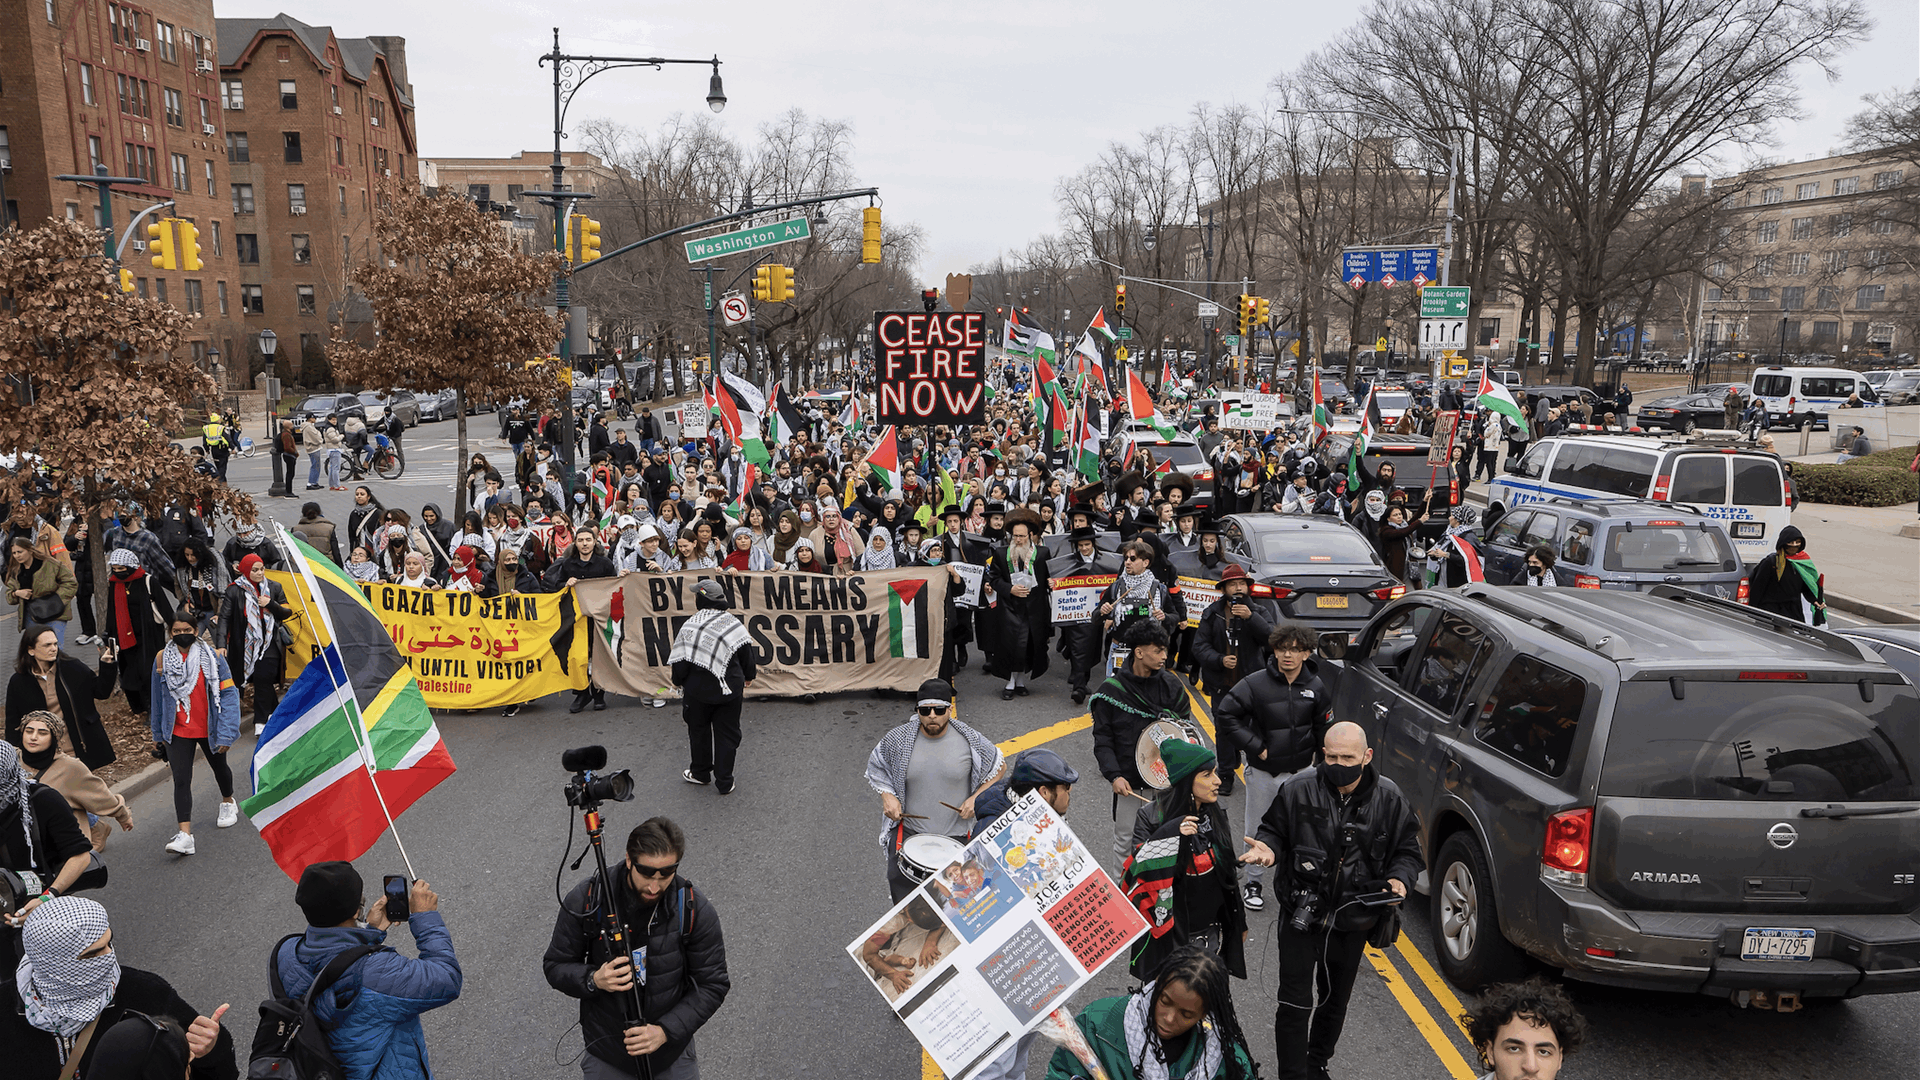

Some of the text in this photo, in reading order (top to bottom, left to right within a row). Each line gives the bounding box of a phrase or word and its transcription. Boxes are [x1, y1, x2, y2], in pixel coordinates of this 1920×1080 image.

[694, 225, 800, 256] Washington Av
[1380, 252, 1399, 260] Brooklyn
[1412, 251, 1431, 259] Brooklyn
[1346, 259, 1370, 267] Children's
[879, 314, 983, 348] CEASE
[886, 348, 977, 379] FIRE
[685, 404, 705, 412] JEWS
[881, 380, 983, 417] NOW
[1510, 492, 1545, 508] NYP
[649, 575, 867, 612] BY NY MEANS
[1055, 577, 1084, 588] Judaism
[382, 587, 435, 616] GAZA
[446, 593, 472, 617] TO
[1057, 612, 1072, 620] And
[1058, 603, 1087, 611] "Israel"
[408, 626, 466, 653] حتى
[468, 623, 519, 658] ثورة
[642, 614, 880, 667] NSSARY
[421, 658, 468, 678] UNTIL
[978, 793, 1037, 846] GENOCIDE
[1030, 812, 1054, 835] JOE
[1032, 855, 1087, 906] JOE GO!
[1630, 872, 1914, 884] ARMADA SE
[1047, 877, 1101, 924] THOSE SILENT
[1053, 882, 1110, 932] IN THE FACE OF
[1059, 891, 1114, 939] GENOCIDE ARE
[1000, 935, 1022, 955] people
[1018, 925, 1033, 938] who
[1065, 912, 1103, 946] NOT ONLY
[1071, 916, 1113, 953] COWARDS.
[1077, 927, 1115, 960] THEY ARE
[986, 931, 1039, 978] block aid trucks to
[990, 937, 1047, 987] feed hungry children
[1083, 928, 1128, 968] COMPLICIT!
[1748, 938, 1807, 955] DYJ 7295
[1001, 979, 1013, 990] are
[1035, 947, 1049, 960] and
[1001, 950, 1059, 1003] people who block sea
[1012, 961, 1062, 1005] routes to prevent
[1024, 974, 1061, 1008] genocide are
[1031, 980, 1066, 1012] terrorists.
